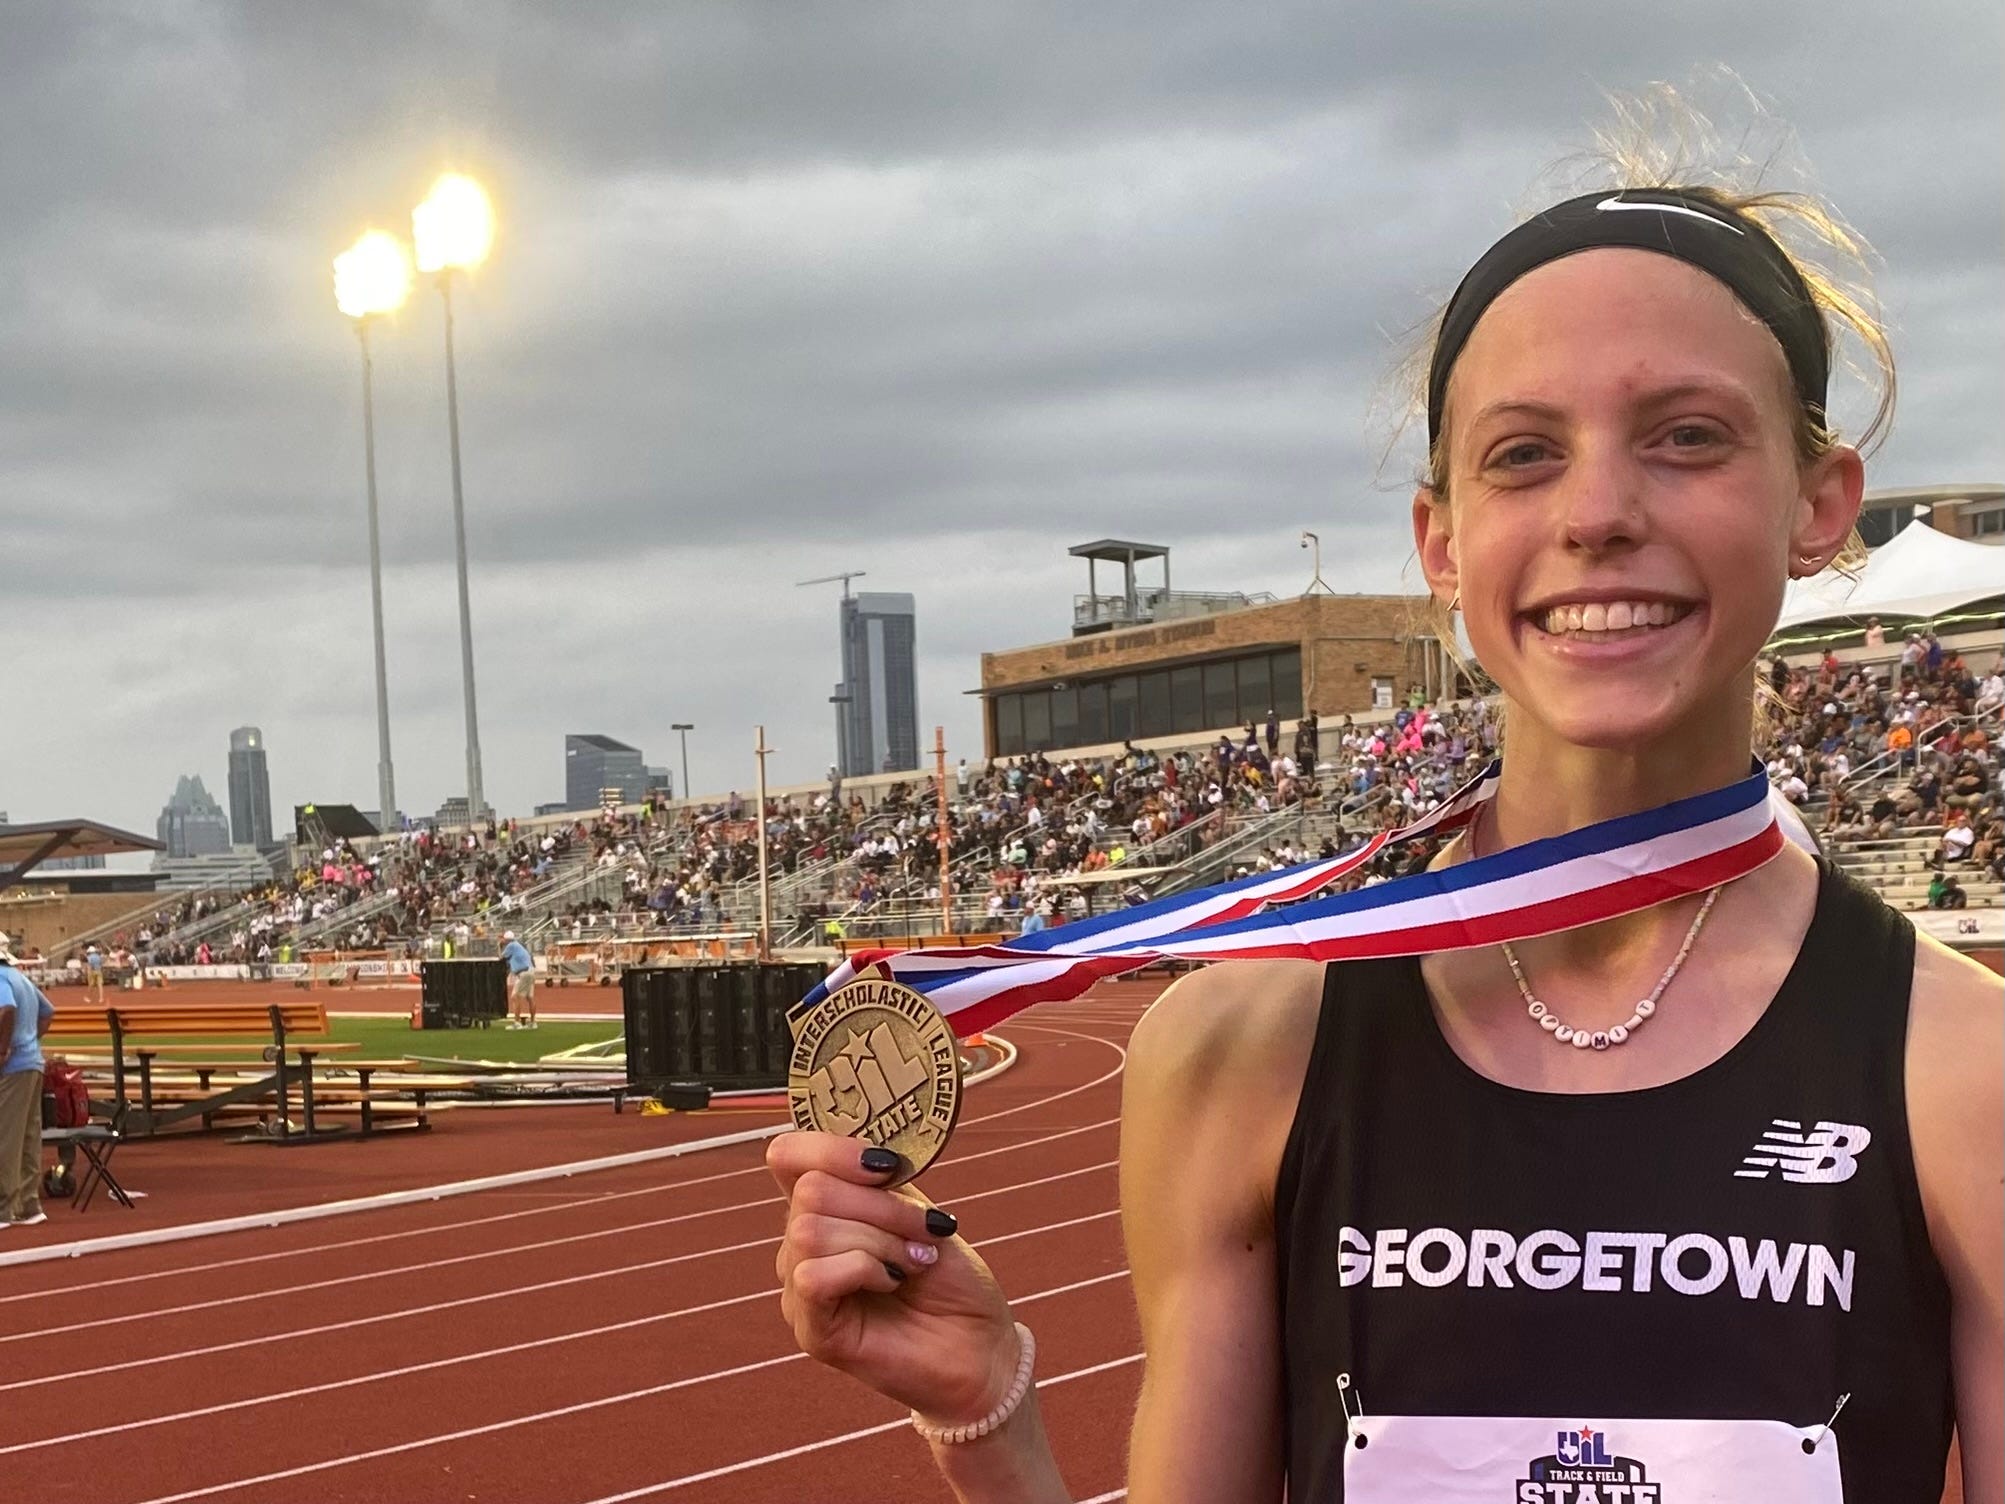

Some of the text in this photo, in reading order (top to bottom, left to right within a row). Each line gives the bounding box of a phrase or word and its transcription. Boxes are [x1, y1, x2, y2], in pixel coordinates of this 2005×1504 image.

[793, 984, 928, 1072] INTERSCHOLASTIC
[929, 1032, 953, 1123] LEAGUE
[1733, 1118, 1872, 1184] NB
[1338, 1226, 1856, 1313] GEORGETOWN
[1549, 1469, 1625, 1483] TRACK & FIELD
[1557, 1424, 1613, 1466] UIL
